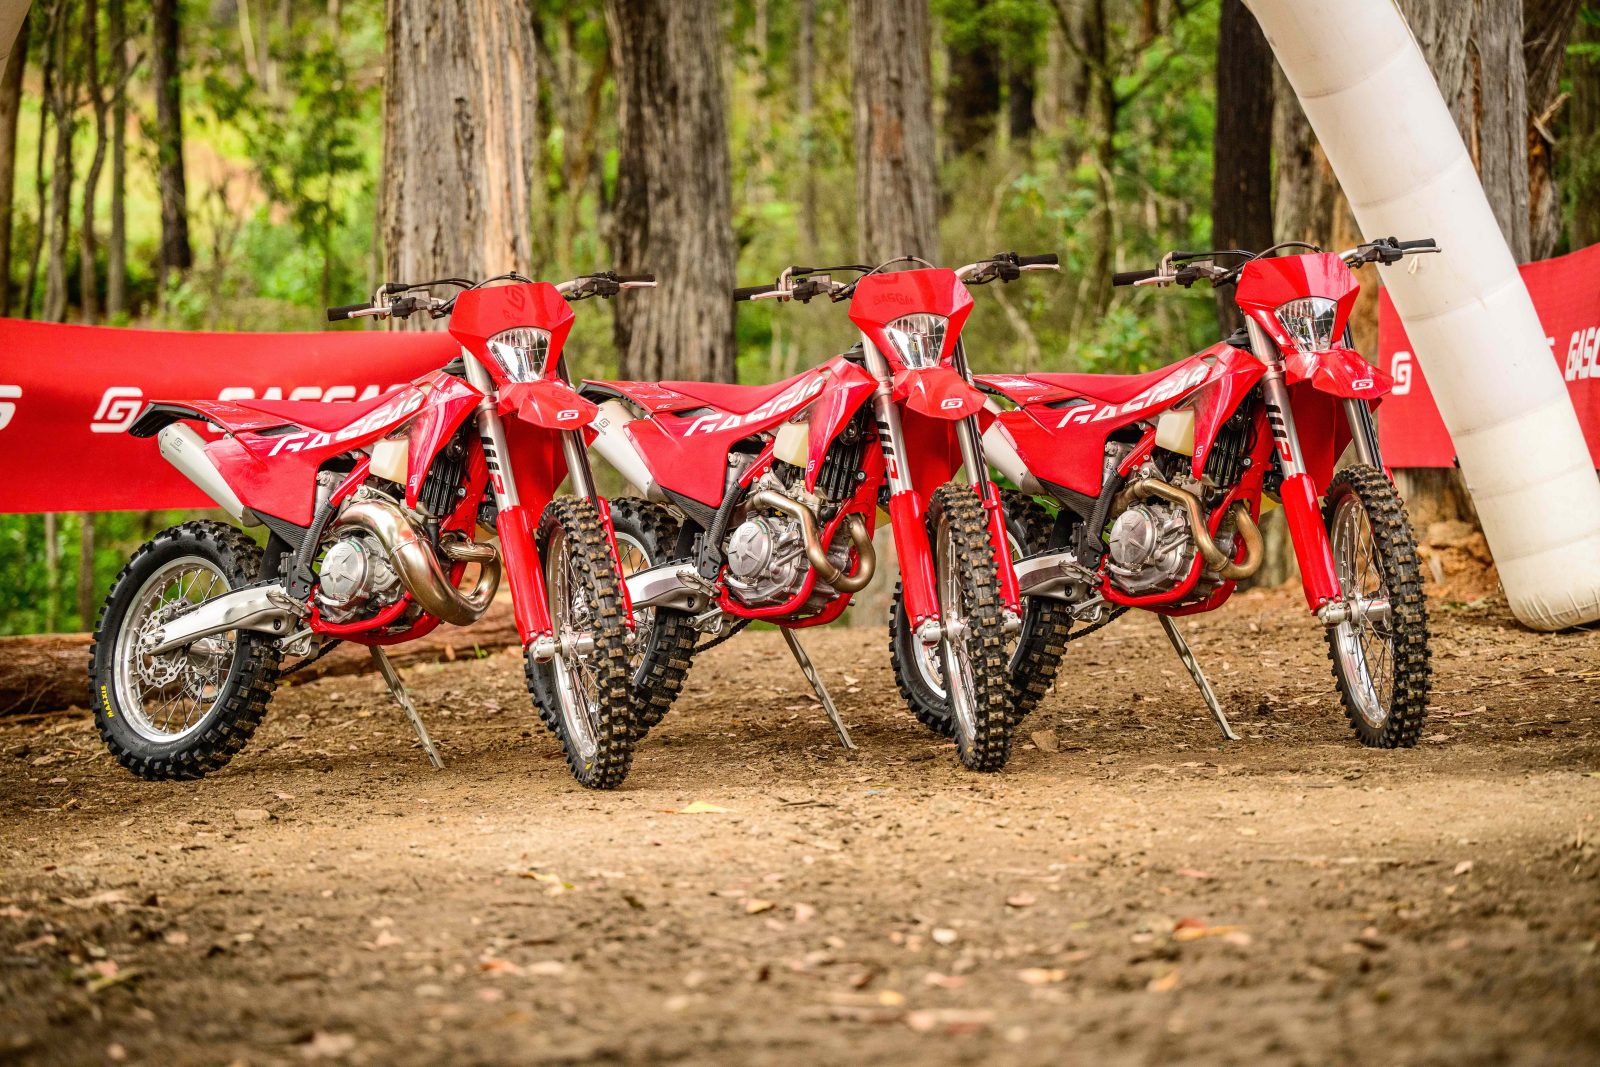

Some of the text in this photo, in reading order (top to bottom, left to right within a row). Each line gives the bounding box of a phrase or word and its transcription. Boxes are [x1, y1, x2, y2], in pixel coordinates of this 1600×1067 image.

[267, 389, 424, 456] GASGAS
[684, 375, 824, 437] GASGAS
[1056, 364, 1209, 428] GASGAS
[100, 685, 115, 718] MAXXIS
